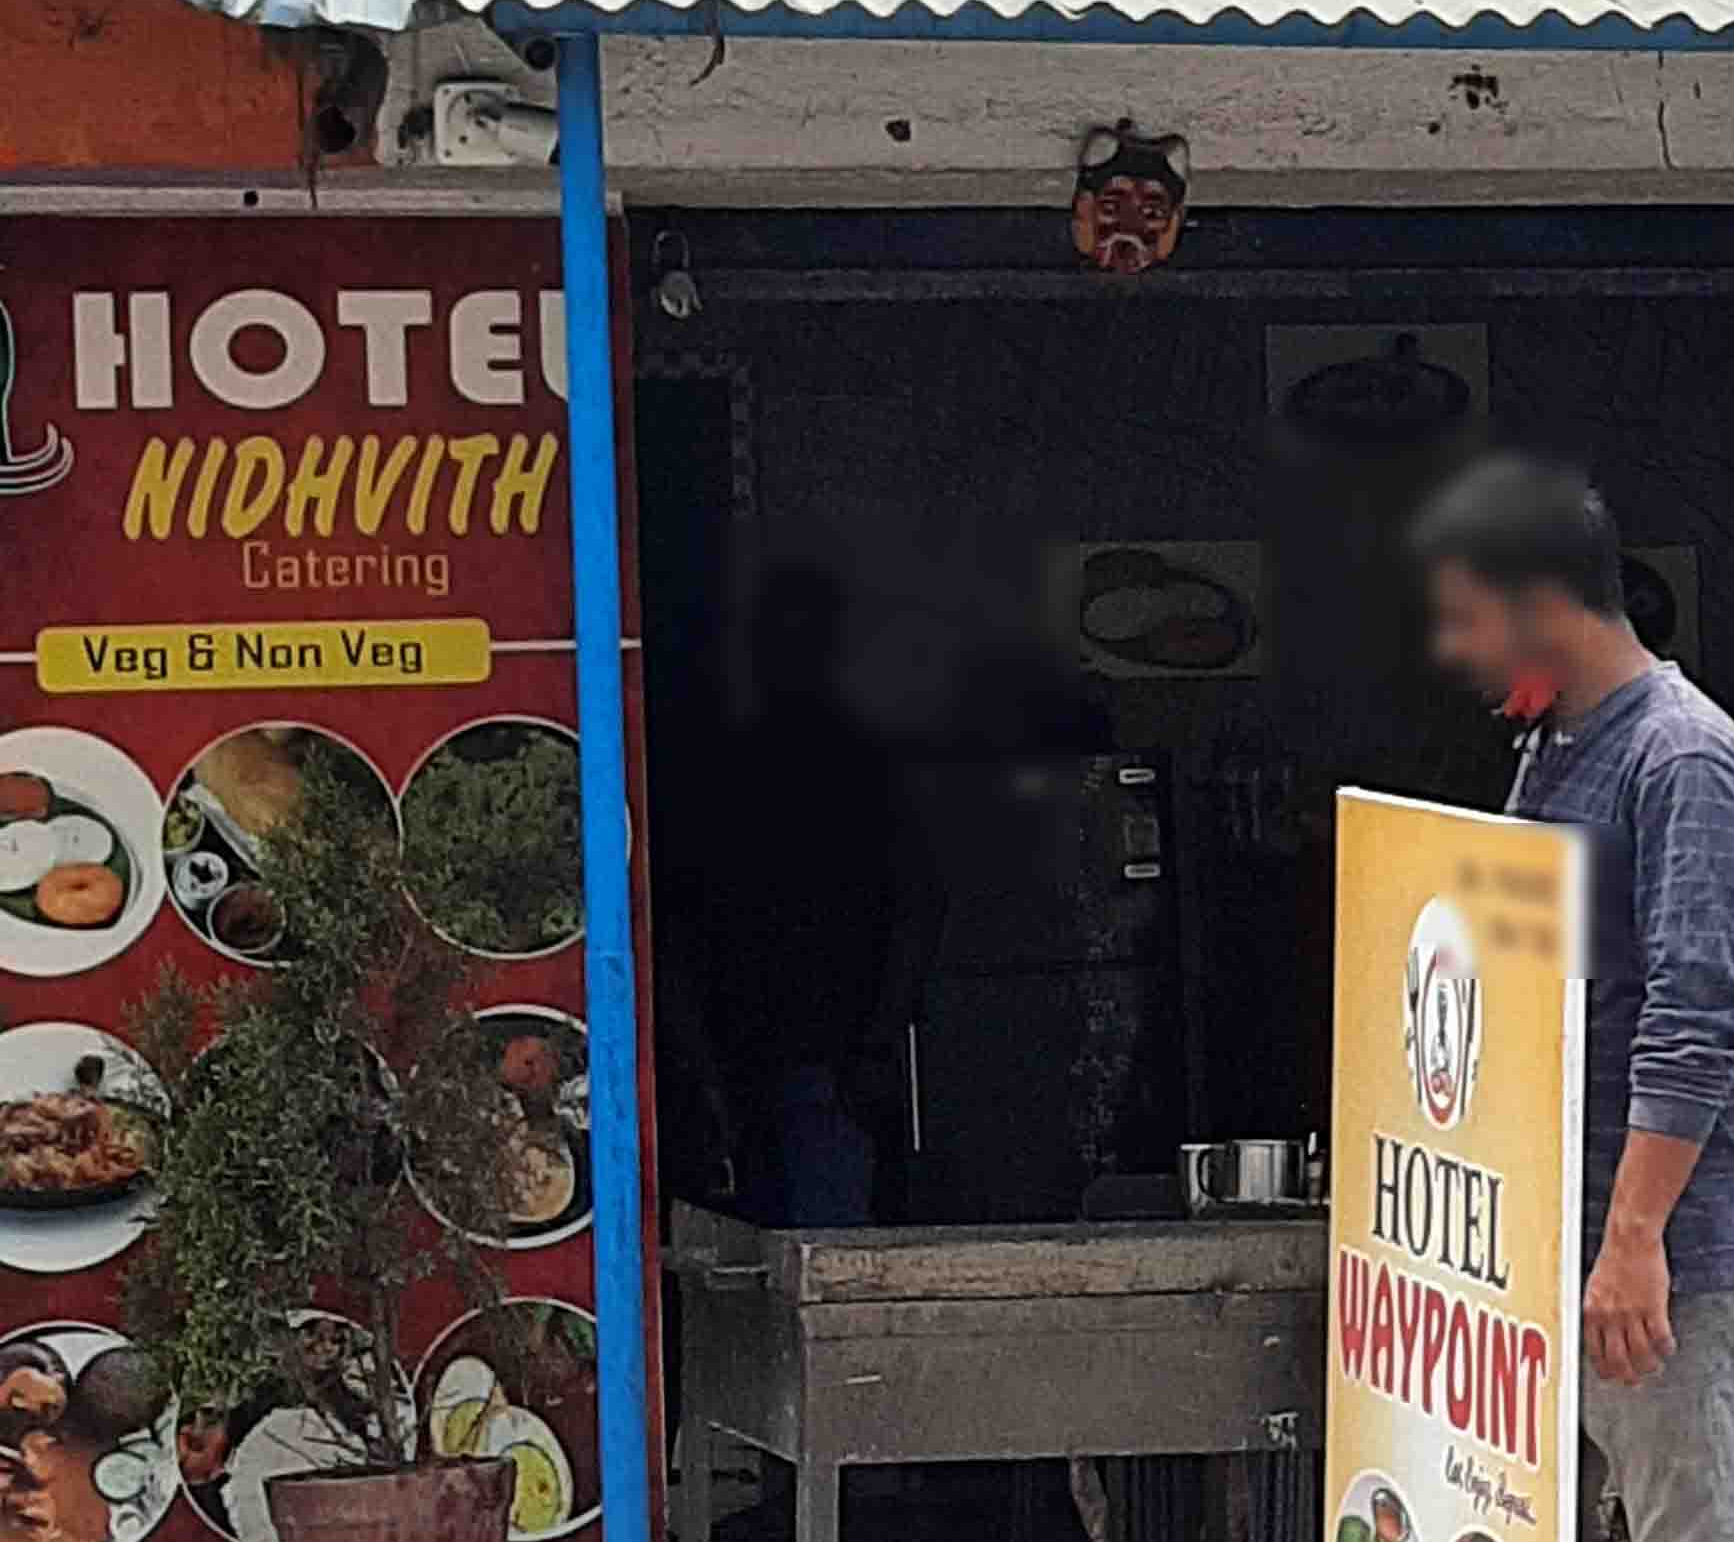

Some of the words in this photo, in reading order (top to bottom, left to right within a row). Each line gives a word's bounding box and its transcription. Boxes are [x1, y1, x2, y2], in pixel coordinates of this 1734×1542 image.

[123, 433, 559, 540] NIDHVITH
[242, 542, 449, 596] Catering
[83, 635, 169, 679] Veg
[235, 633, 323, 669] Non
[341, 630, 424, 673] Veg
[1371, 1133, 1511, 1292] HOTEL
[1339, 1248, 1550, 1467] WAYPOINT
